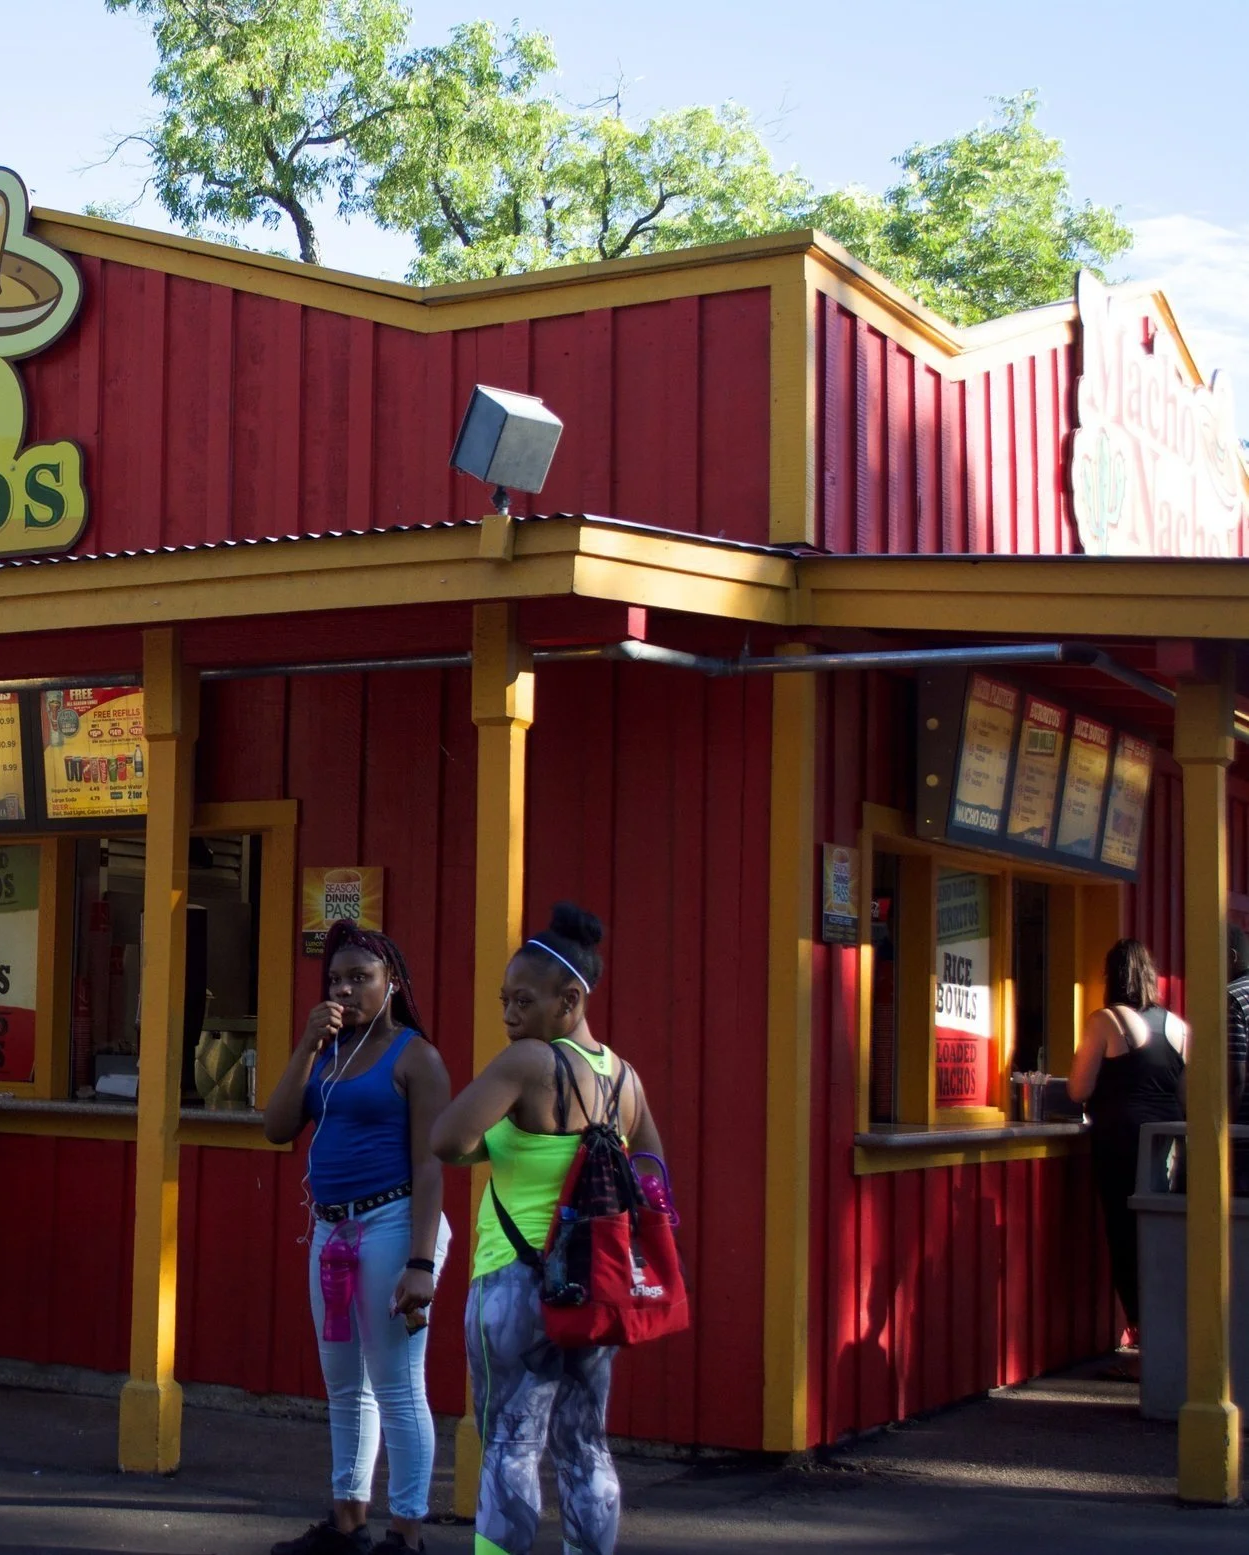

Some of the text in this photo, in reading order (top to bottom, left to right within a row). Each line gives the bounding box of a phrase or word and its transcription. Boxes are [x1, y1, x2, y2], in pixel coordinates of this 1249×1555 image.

[69, 688, 93, 700] FREE
[93, 708, 140, 718] FREE REFILLS
[955, 805, 978, 826] MUCHO
[980, 811, 998, 831] GOOD
[325, 883, 360, 893] SEASON
[325, 894, 360, 902] DINING
[325, 903, 360, 919] PASS
[943, 952, 972, 987] RICE
[935, 983, 977, 1020] BOWLS
[935, 1042, 977, 1063] LOADED
